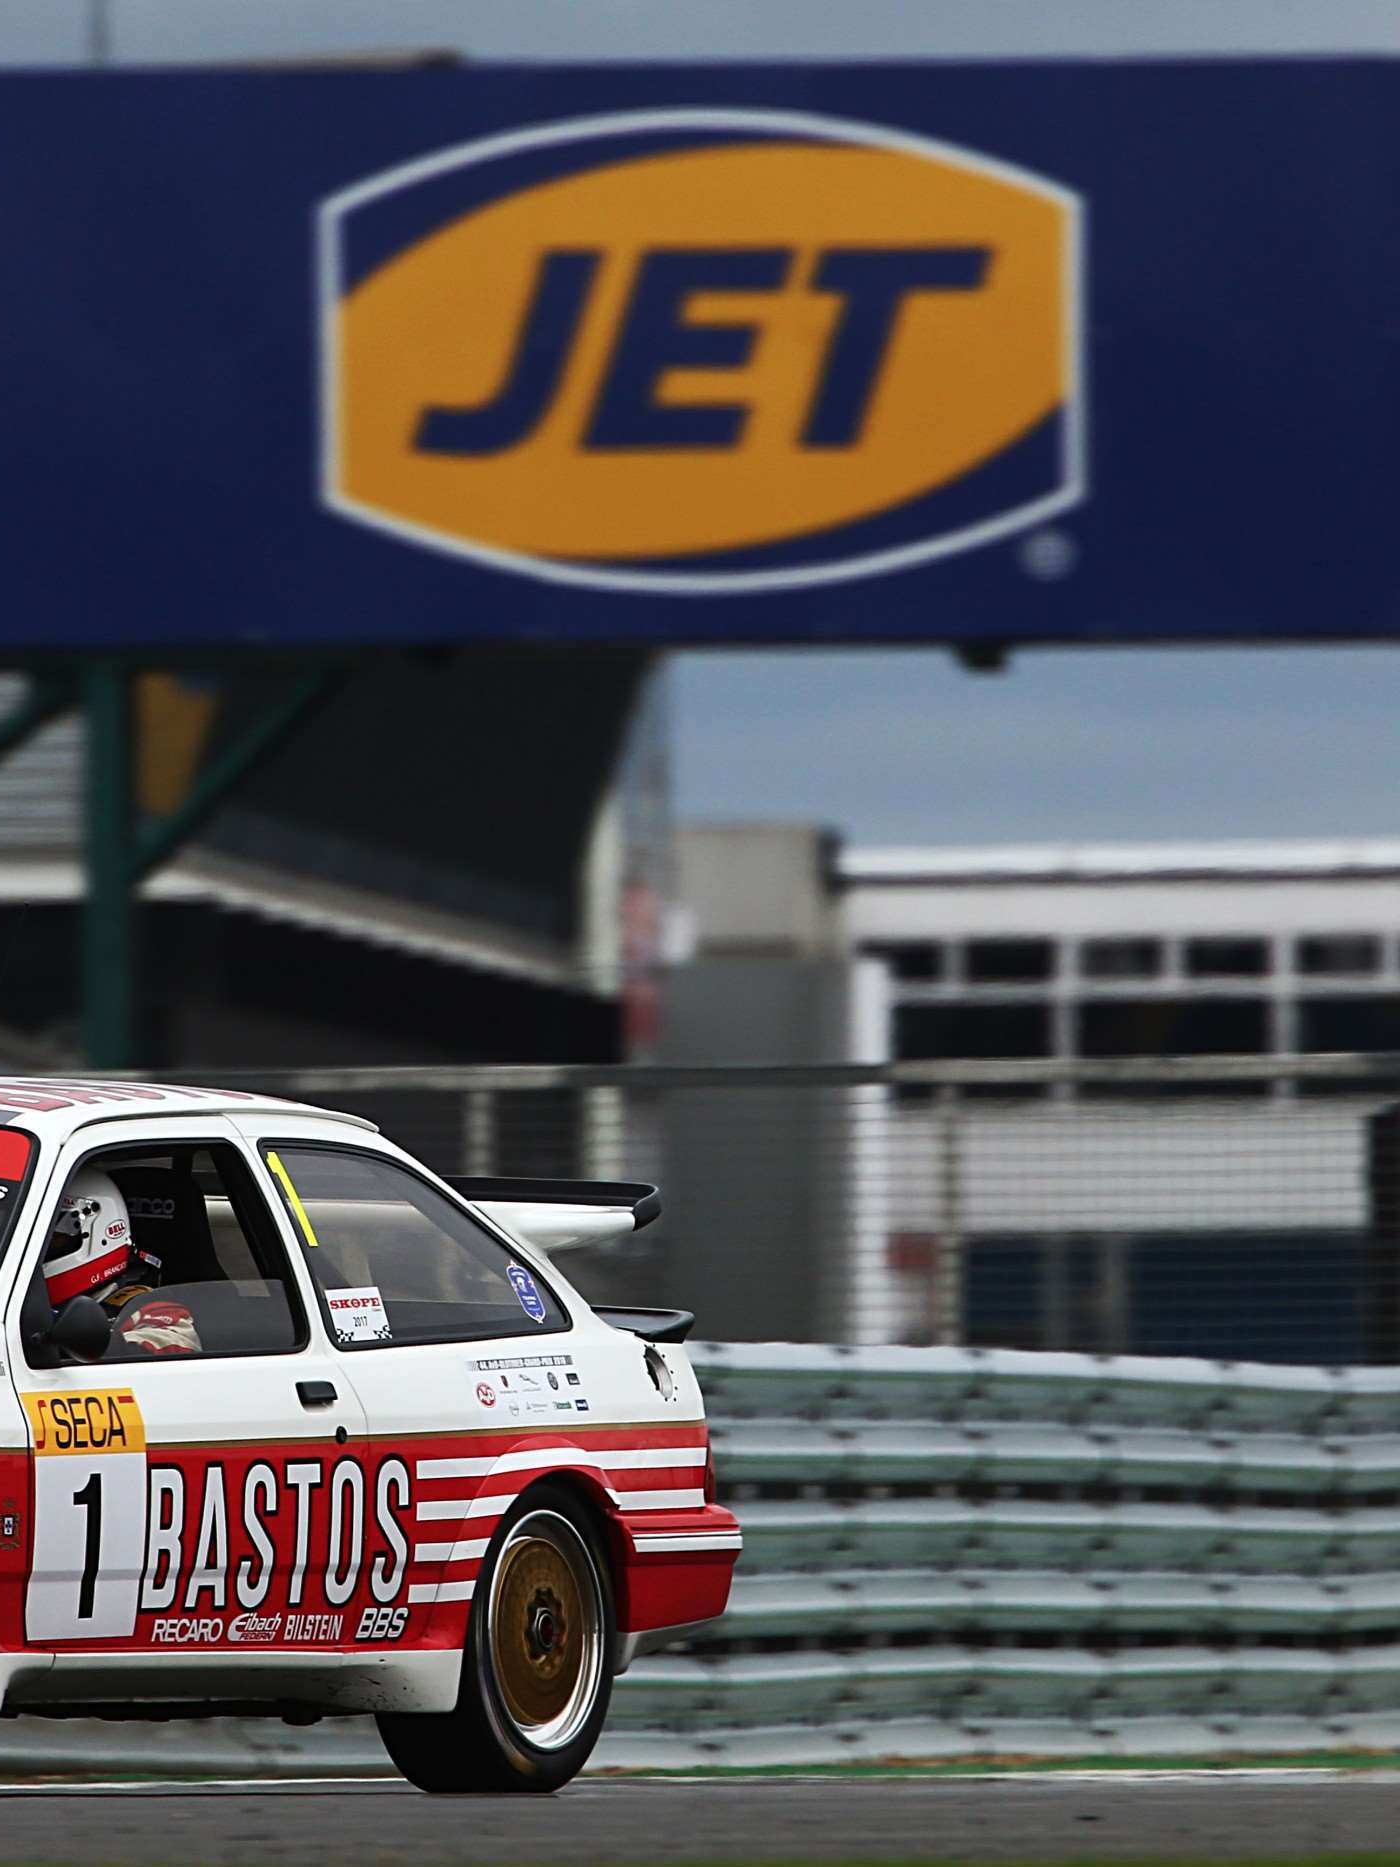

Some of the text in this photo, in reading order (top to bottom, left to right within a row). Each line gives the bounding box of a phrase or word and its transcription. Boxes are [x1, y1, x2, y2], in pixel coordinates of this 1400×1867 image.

[408, 245, 996, 460] JET
[107, 1222, 126, 1236] BELL
[267, 1152, 319, 1247] 1
[330, 1297, 380, 1309] SKOPE
[73, 1473, 103, 1619] 1
[141, 1458, 410, 1609] BASTOS
[151, 1607, 408, 1642] RECARO Eibach BILSTEIN BBS
